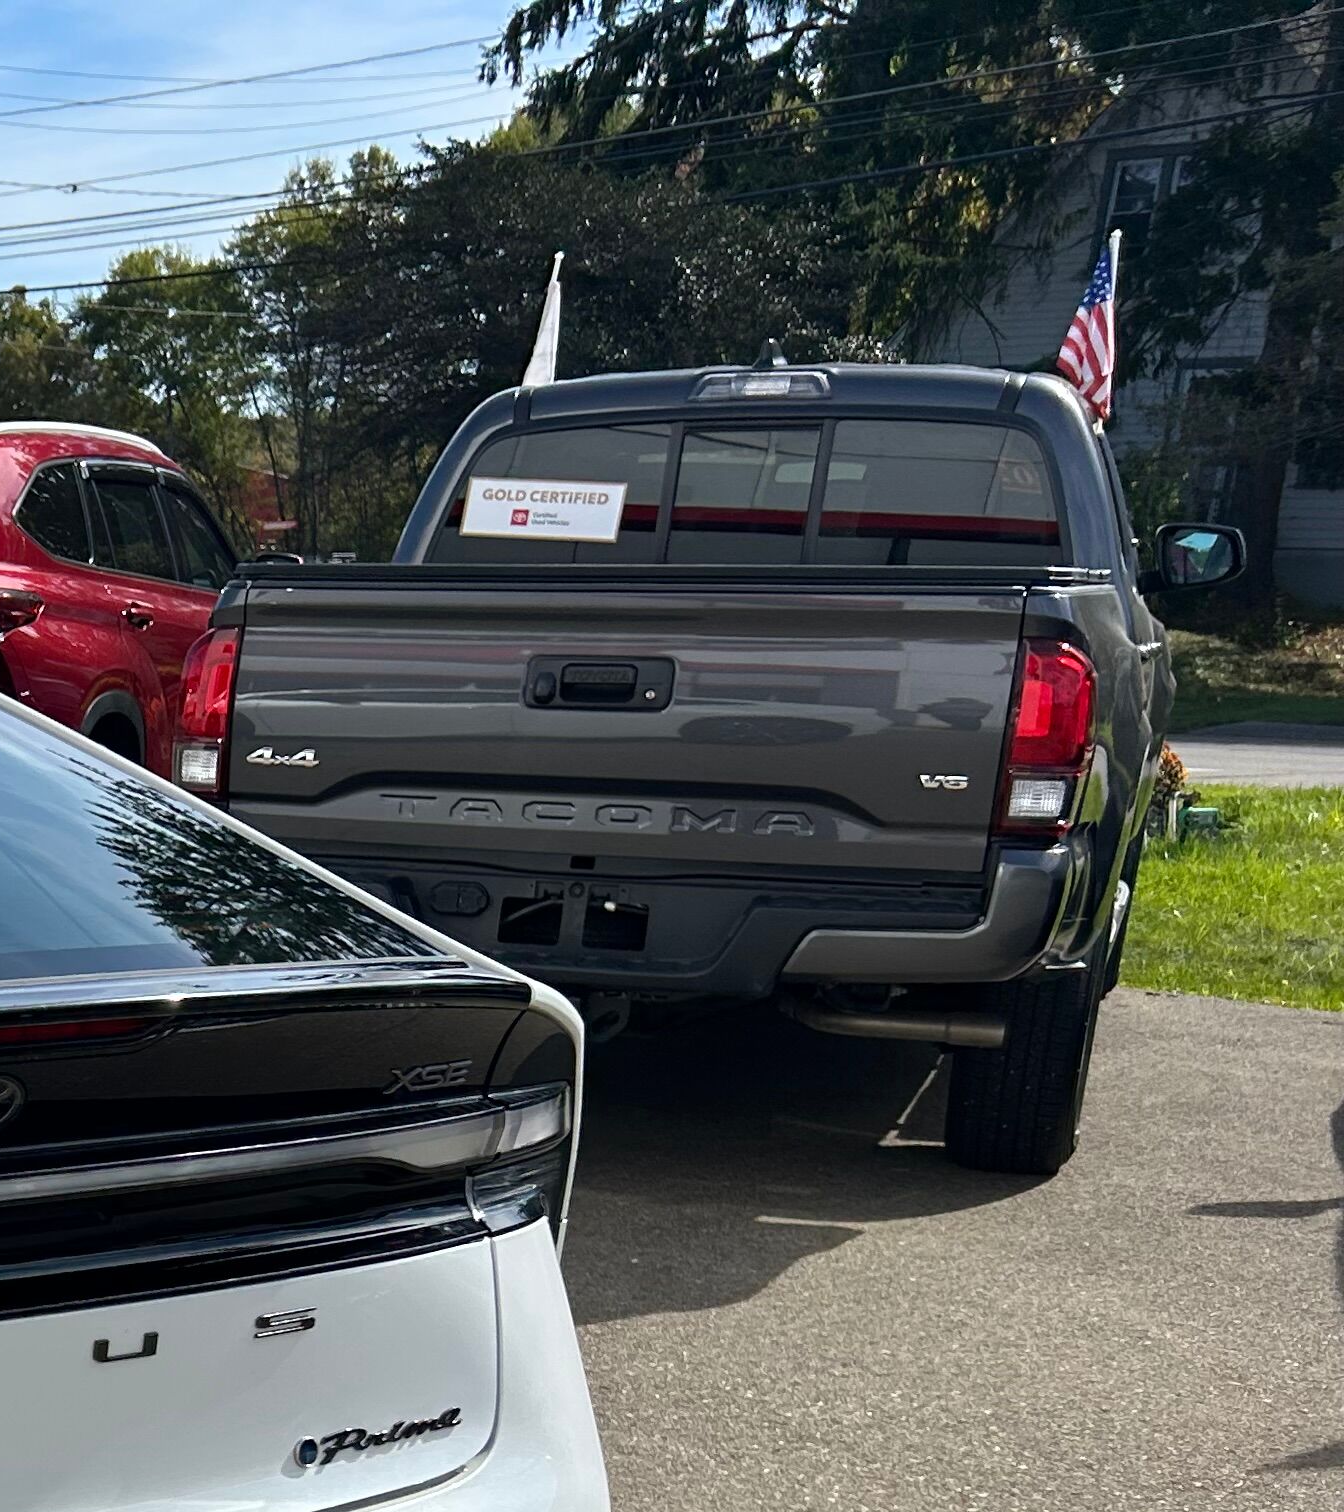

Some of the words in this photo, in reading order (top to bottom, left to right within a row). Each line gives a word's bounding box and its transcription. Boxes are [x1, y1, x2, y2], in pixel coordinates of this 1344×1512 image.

[482, 488, 526, 502] GOLD
[530, 490, 609, 505] CERTIFIED
[246, 746, 321, 768] 4x4
[919, 774, 969, 790] V6
[380, 794, 814, 836] TACOMA
[382, 1060, 473, 1095] XSE
[320, 1407, 464, 1466] Prime
